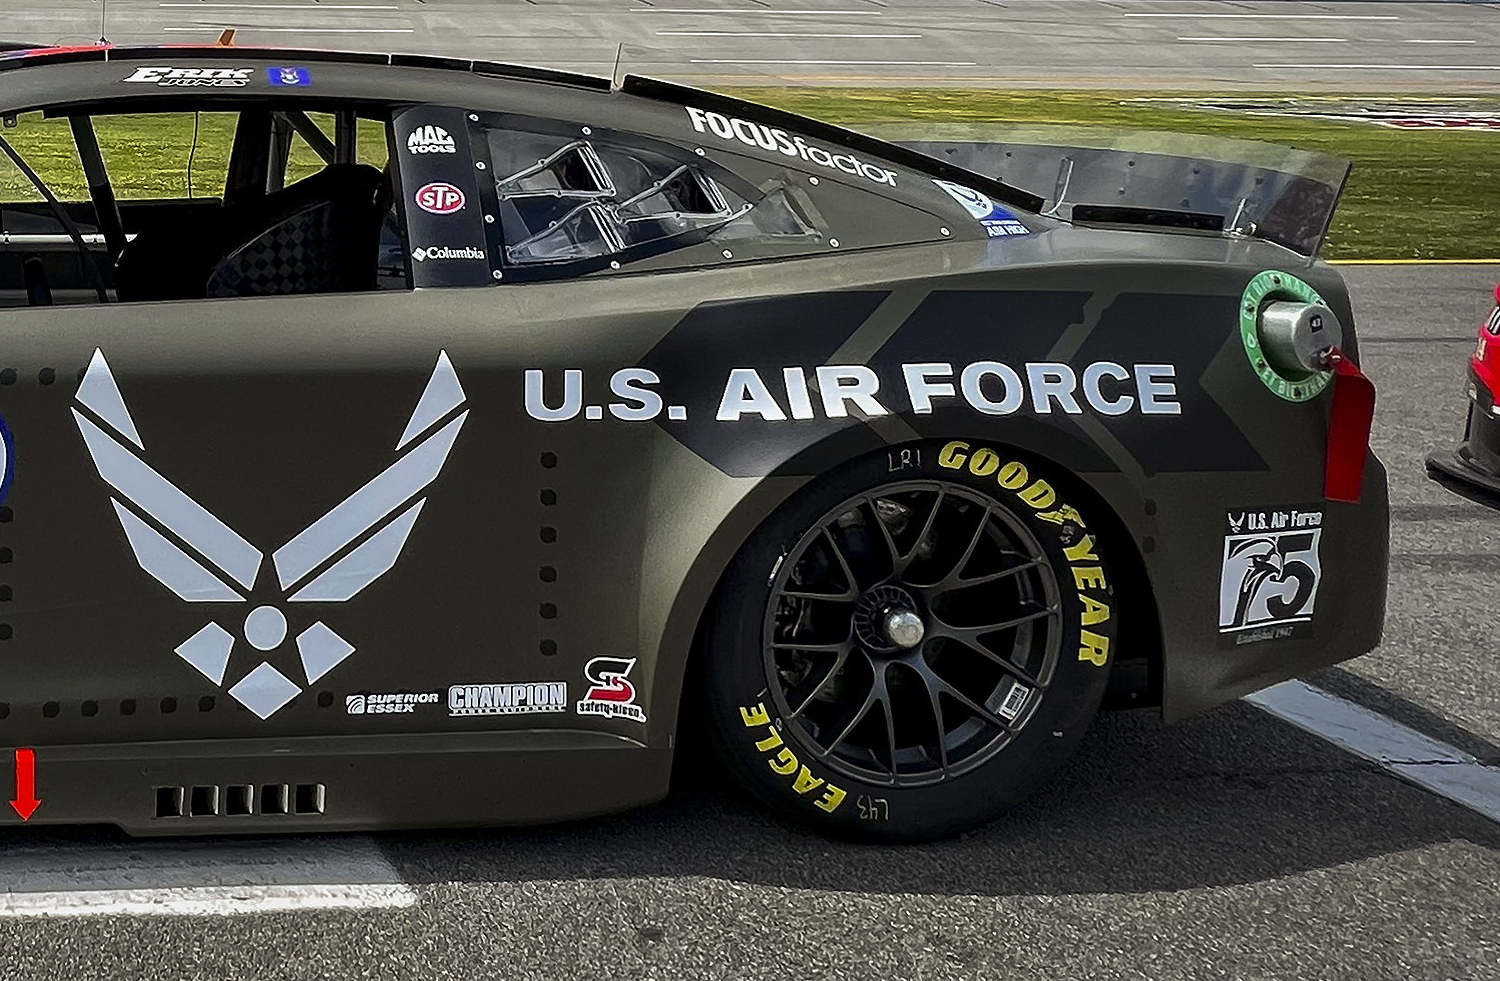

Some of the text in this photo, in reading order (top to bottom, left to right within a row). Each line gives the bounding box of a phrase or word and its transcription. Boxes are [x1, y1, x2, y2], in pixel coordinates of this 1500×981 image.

[123, 66, 255, 83] ERIK
[407, 124, 456, 146] MAC
[407, 145, 457, 155] TOOLS
[421, 185, 461, 210] STP
[426, 246, 485, 260] Columbia
[523, 361, 1184, 421] U.S. AIR FORCE
[1248, 510, 1323, 530] U.S. Air Force
[367, 693, 439, 704] SUPERIOR
[450, 683, 566, 710] CHAMPION
[367, 703, 415, 714] ESSEX
[739, 702, 848, 814] EAGLE
